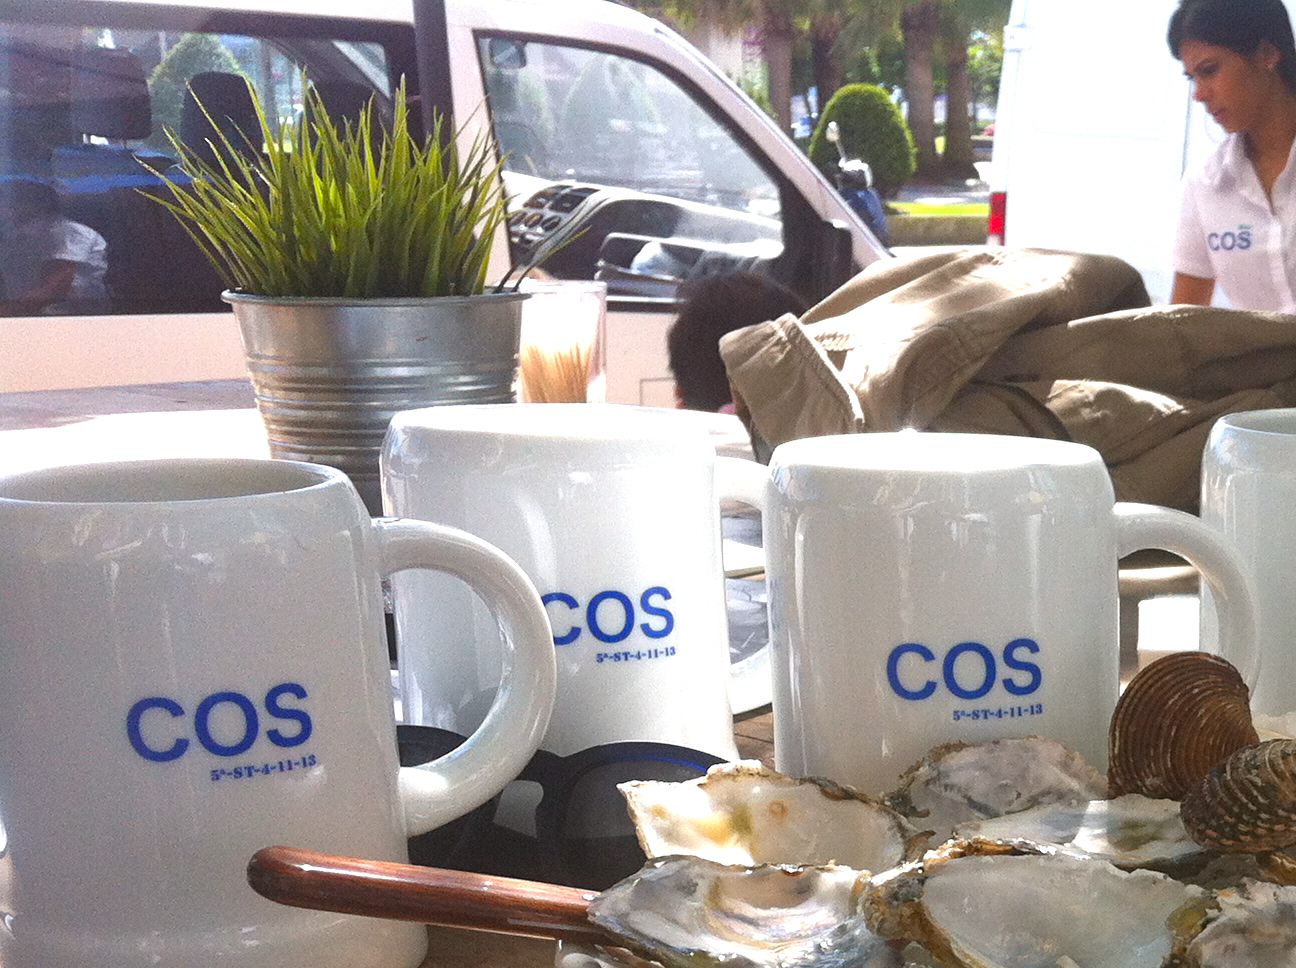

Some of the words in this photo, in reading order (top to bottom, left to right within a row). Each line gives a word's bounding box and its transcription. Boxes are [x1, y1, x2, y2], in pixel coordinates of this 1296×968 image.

[1207, 231, 1252, 251] COS
[887, 637, 1042, 701] COS
[126, 682, 314, 763] COS
